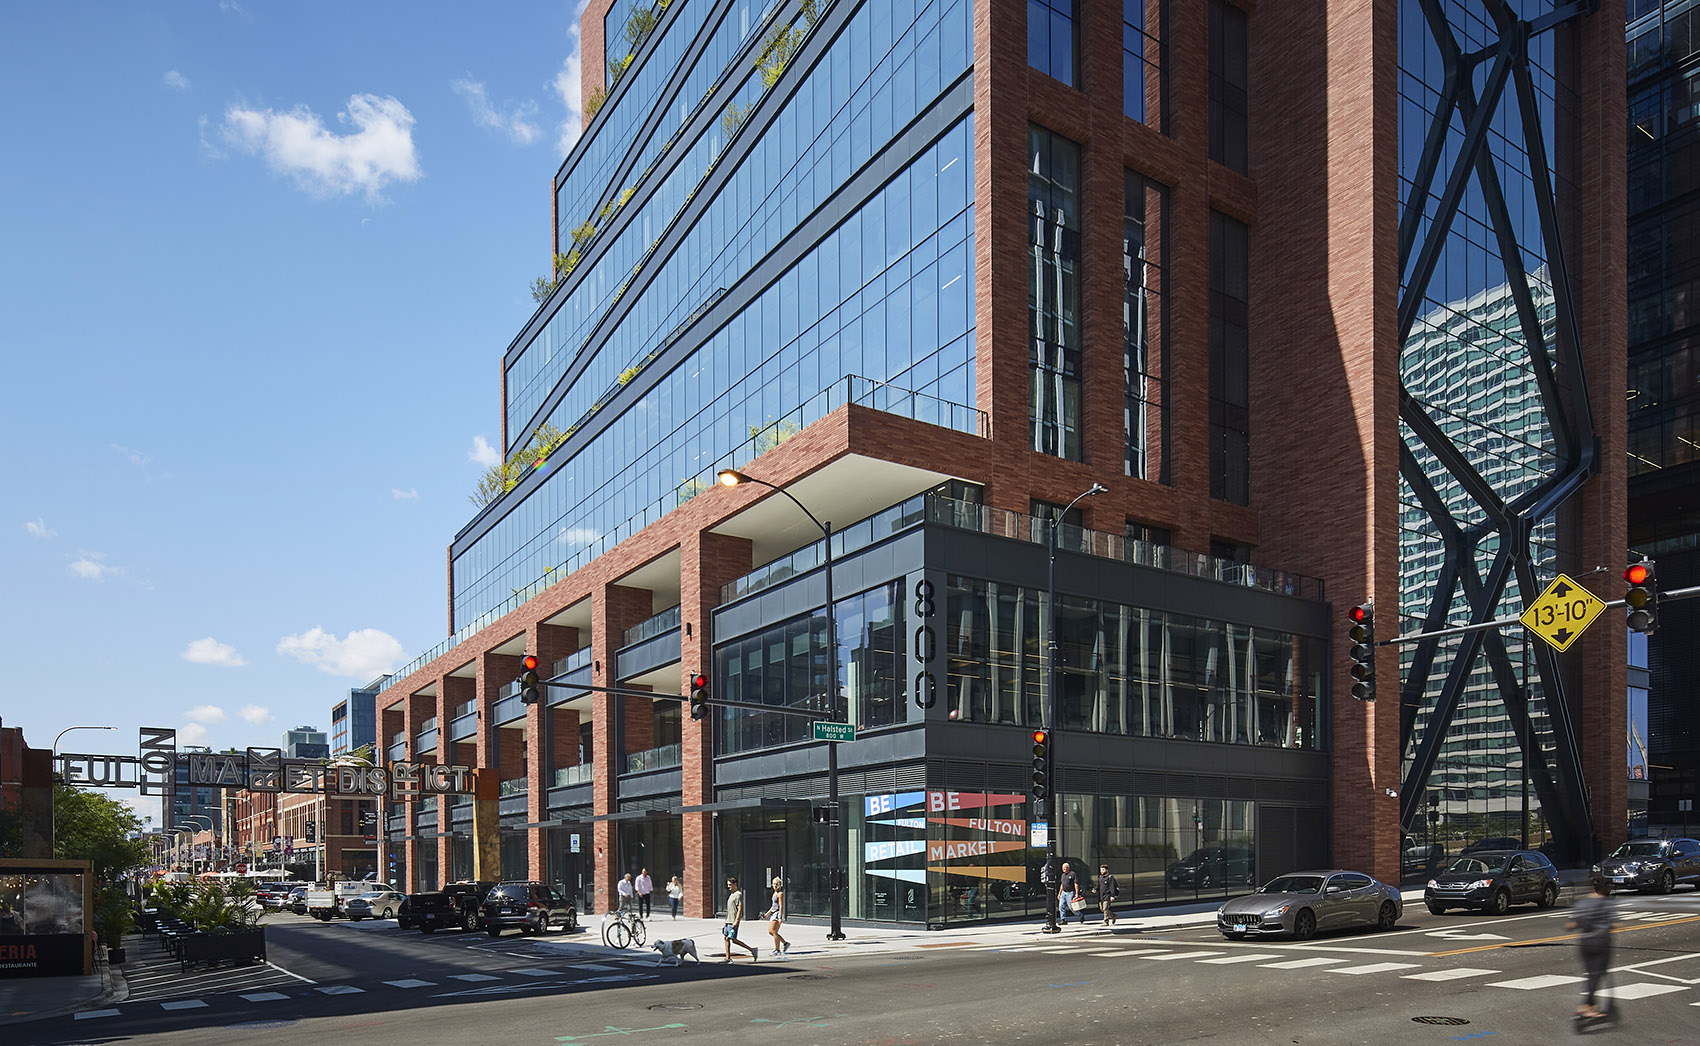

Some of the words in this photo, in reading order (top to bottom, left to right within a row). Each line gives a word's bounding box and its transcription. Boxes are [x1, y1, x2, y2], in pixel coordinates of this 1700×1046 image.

[1533, 598, 1593, 627] 13'-10"
[914, 578, 936, 710] 800
[821, 725, 847, 733] Halsted
[870, 795, 890, 816] BE
[930, 792, 961, 812] BE
[897, 818, 925, 829] FULTON
[969, 818, 1021, 836] FULTON
[870, 840, 919, 861] RETAIL
[931, 841, 997, 861] MARKET
